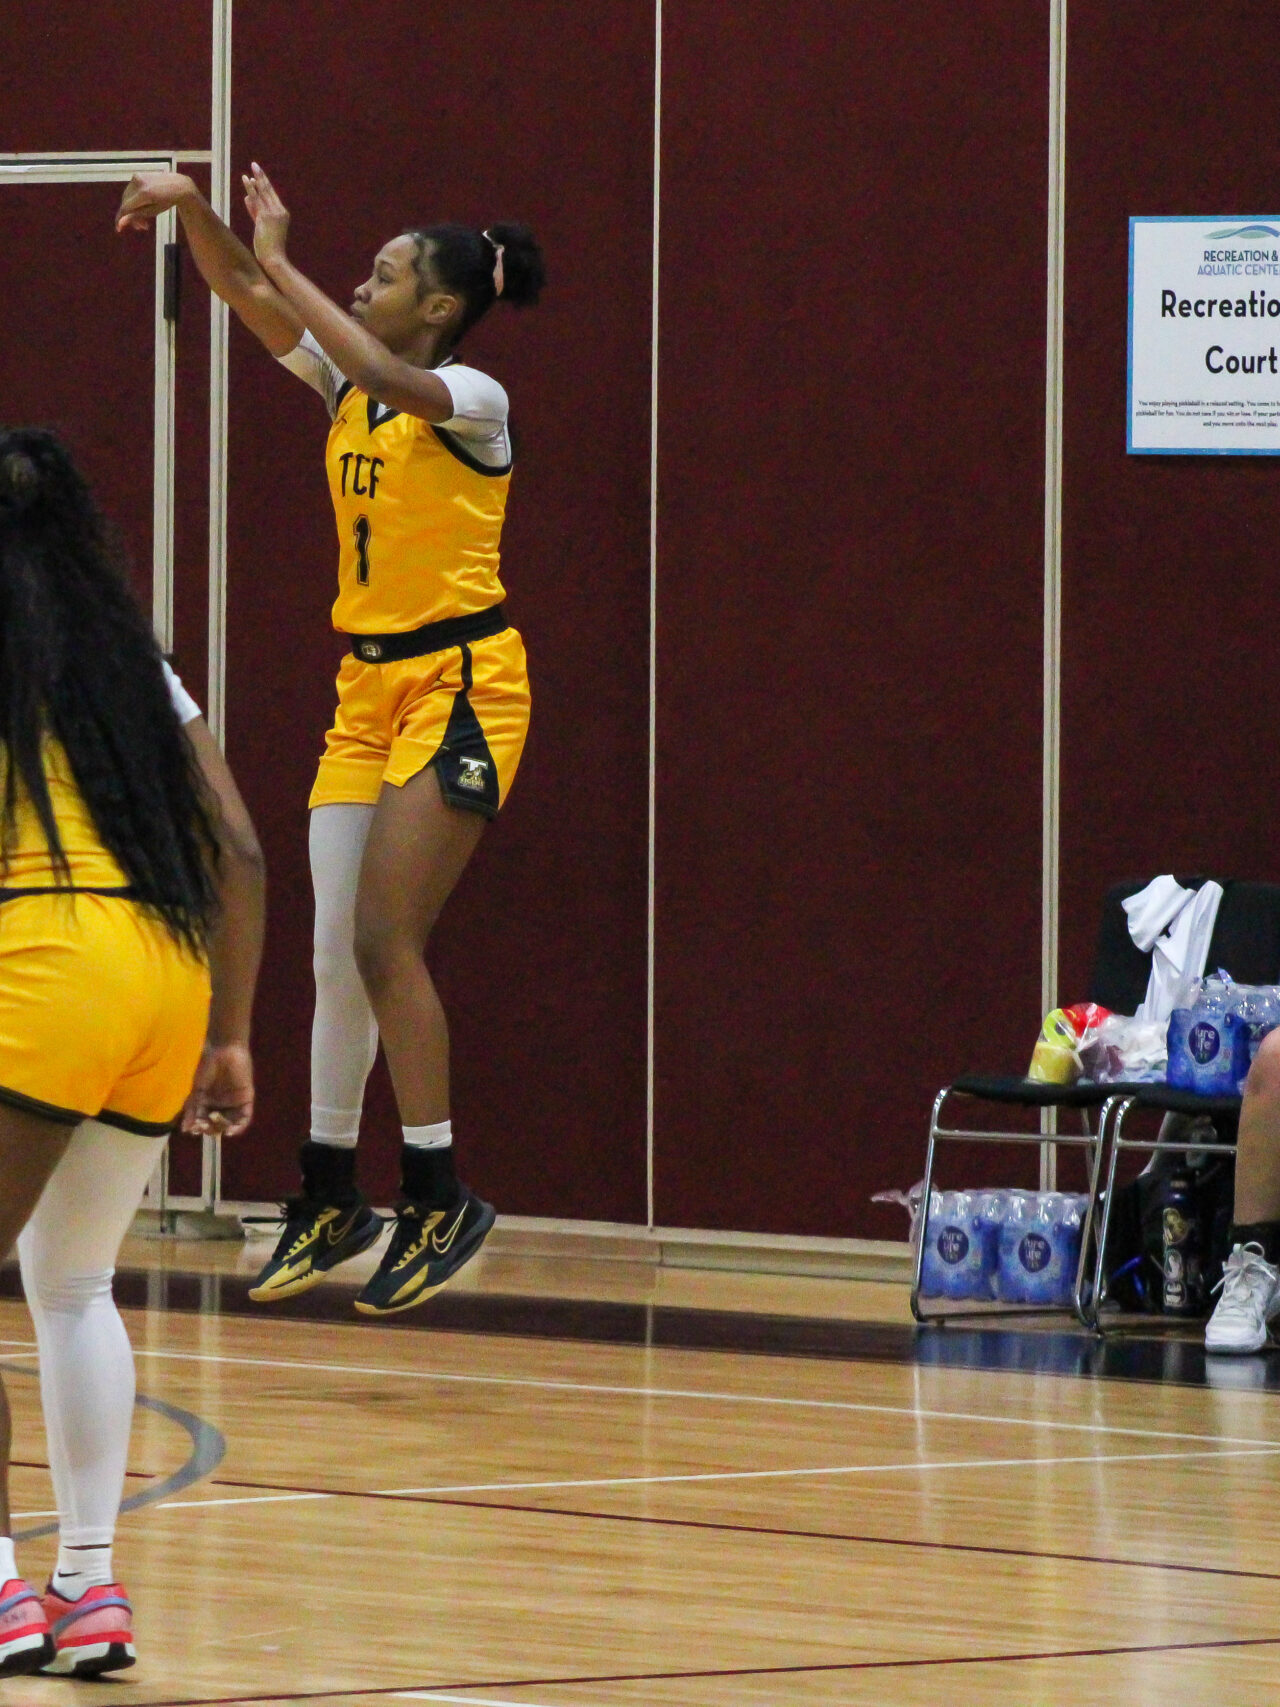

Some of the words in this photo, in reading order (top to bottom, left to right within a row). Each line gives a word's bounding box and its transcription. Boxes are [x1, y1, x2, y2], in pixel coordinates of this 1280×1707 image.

[1197, 264, 1242, 276] AQUATIC
[1245, 264, 1280, 276] CENTE
[1203, 250, 1269, 262] RECREATION
[1271, 250, 1279, 262] &
[1205, 345, 1278, 374] Court
[339, 452, 385, 499] TCF
[353, 514, 371, 587] 1
